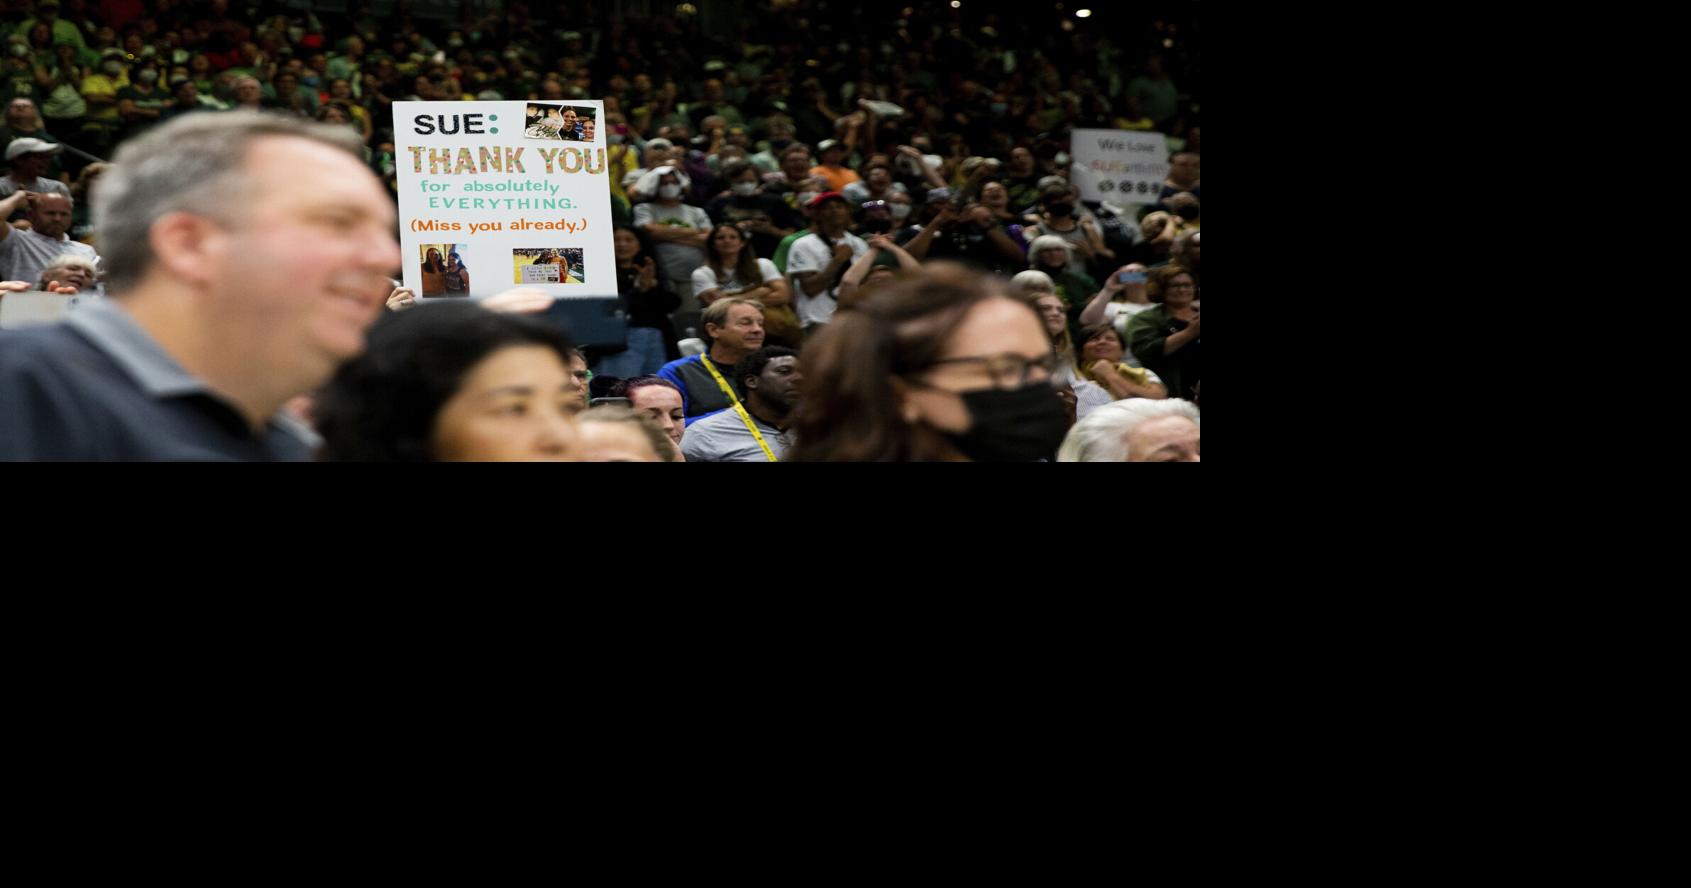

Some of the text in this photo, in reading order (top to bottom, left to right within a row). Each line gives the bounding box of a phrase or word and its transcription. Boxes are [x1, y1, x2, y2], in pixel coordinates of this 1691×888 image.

[413, 113, 499, 135] SUE:
[407, 146, 606, 175] THANK YOU
[420, 179, 560, 196] for absolutely
[429, 196, 578, 210] EVERYTHING.
[410, 218, 588, 235] (Miss you already.)
